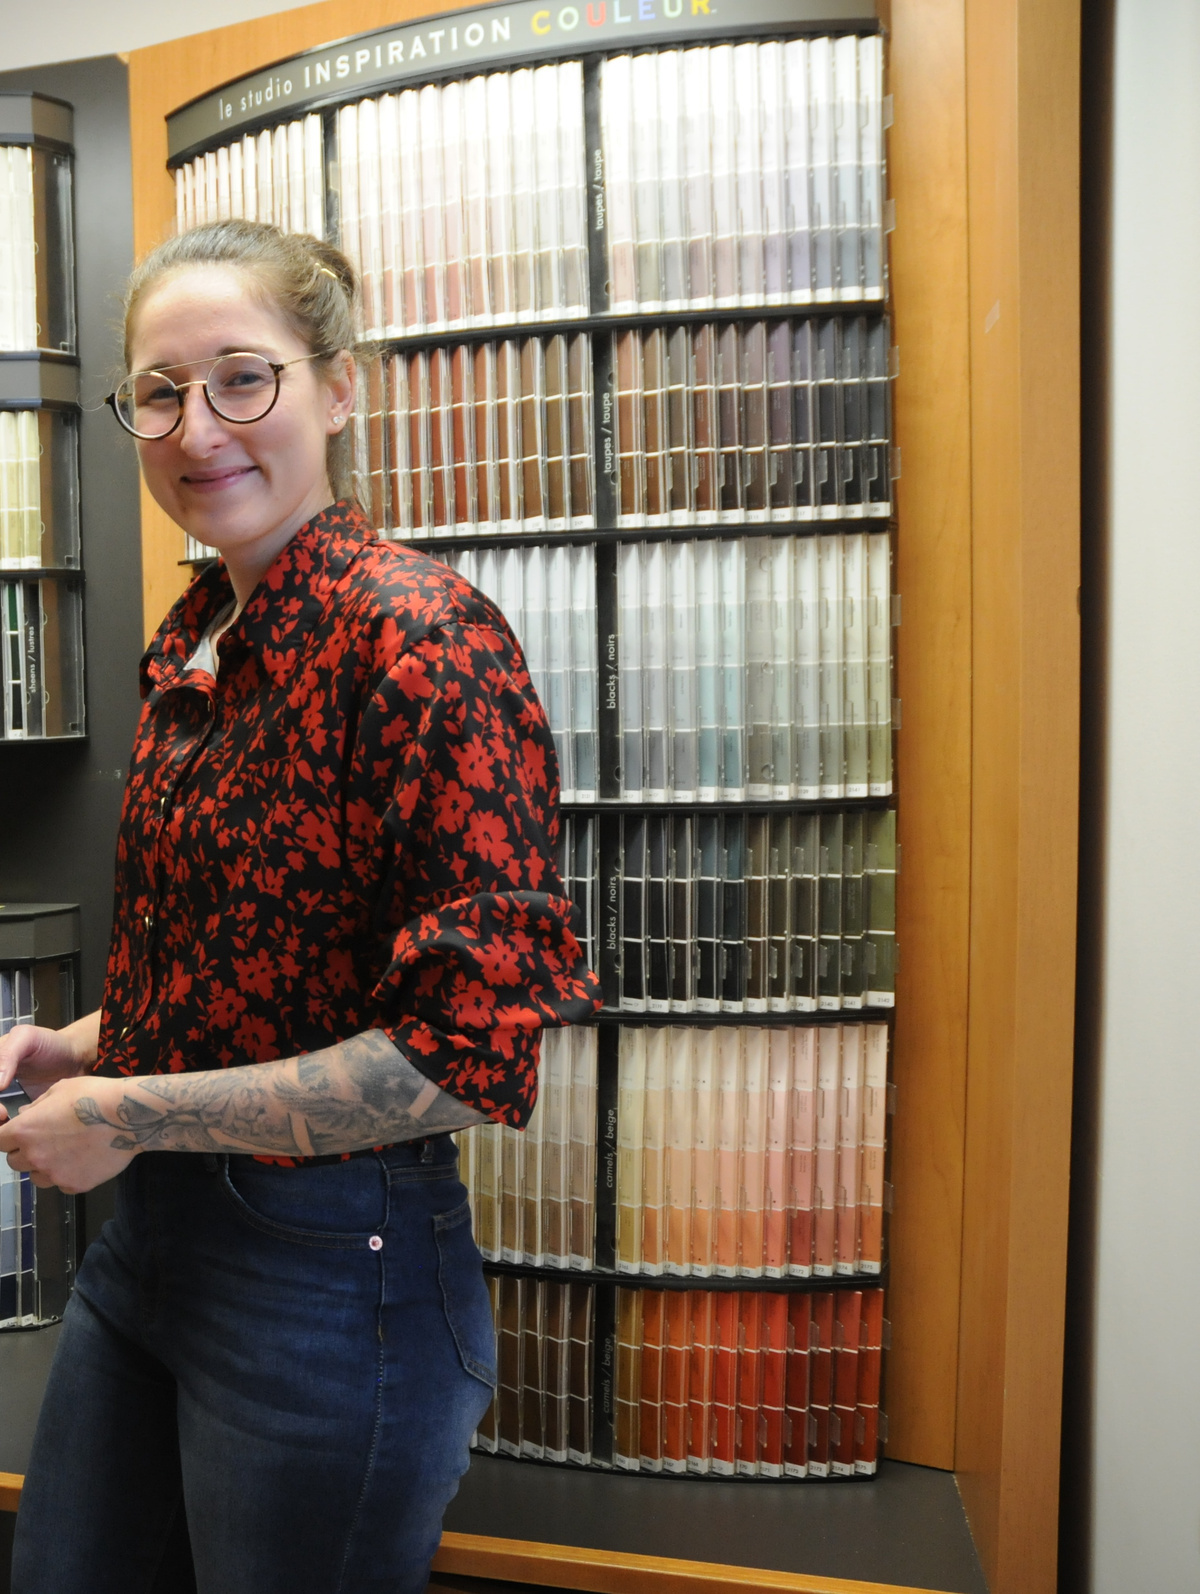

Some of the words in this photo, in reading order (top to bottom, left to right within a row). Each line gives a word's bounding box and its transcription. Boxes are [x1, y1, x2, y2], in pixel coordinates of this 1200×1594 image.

[218, 98, 233, 121] le
[240, 77, 293, 113] studio
[304, 16, 512, 88] INSPIRATION
[530, 0, 711, 36] COULEUR
[594, 149, 605, 181] taupe
[595, 193, 607, 231] taupes
[602, 392, 613, 424] taupe
[603, 437, 614, 474] taupes
[606, 633, 616, 661] noirs
[606, 675, 616, 709] blacks
[607, 876, 617, 902] noirs
[606, 916, 617, 950] blacks
[604, 1109, 616, 1139] beige
[603, 1152, 614, 1188] camels
[602, 1338, 614, 1367] beige
[601, 1379, 611, 1414] camels
